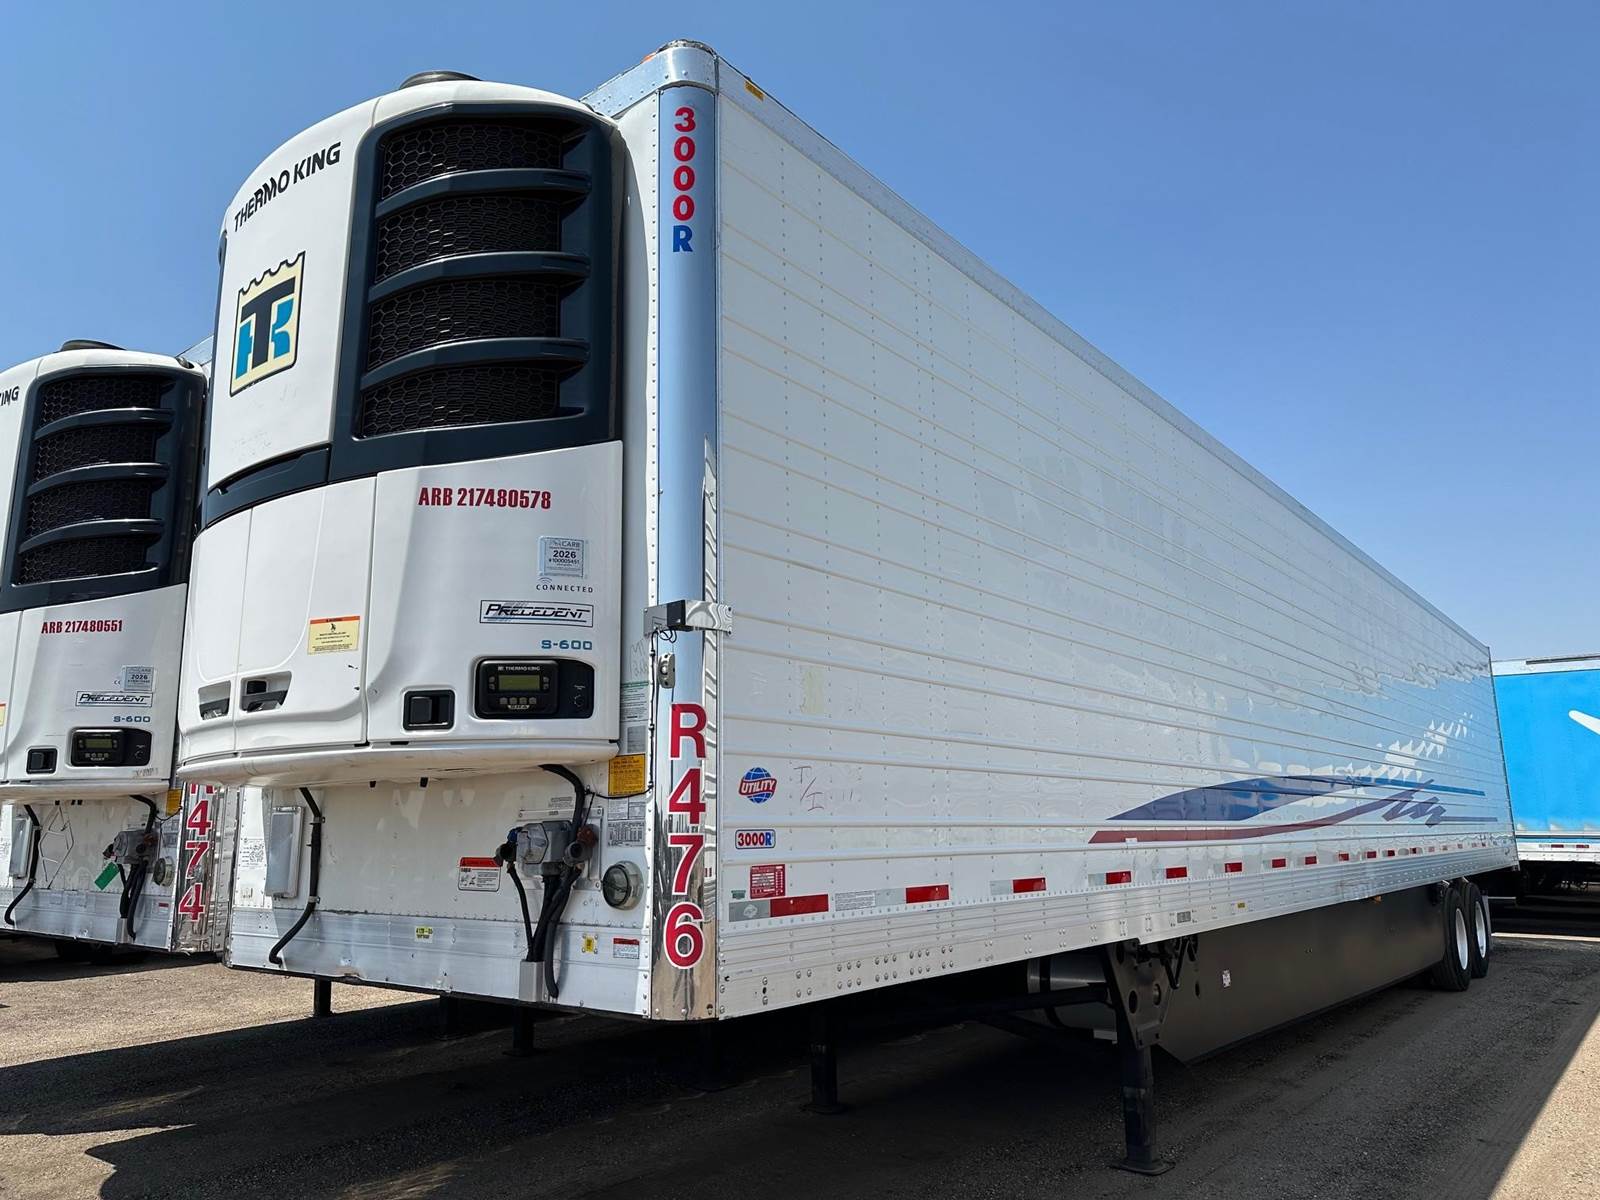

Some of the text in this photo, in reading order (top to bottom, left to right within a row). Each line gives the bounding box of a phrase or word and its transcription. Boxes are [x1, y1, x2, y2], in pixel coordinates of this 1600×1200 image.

[234, 141, 342, 233] THERMO KING
[673, 106, 697, 253] 3000R
[0, 385, 20, 407] ING
[418, 487, 552, 510] ARB 217480578
[552, 550, 577, 559] 2026
[535, 583, 594, 594] CONNECTED
[485, 602, 591, 619] PRECEDENT
[41, 619, 123, 634] ARB 217480551
[541, 639, 593, 651] S-600
[79, 693, 151, 703] PRECEDENT
[113, 715, 151, 723] S-600
[740, 779, 776, 794] UTILITY
[737, 831, 773, 847] 3000R
